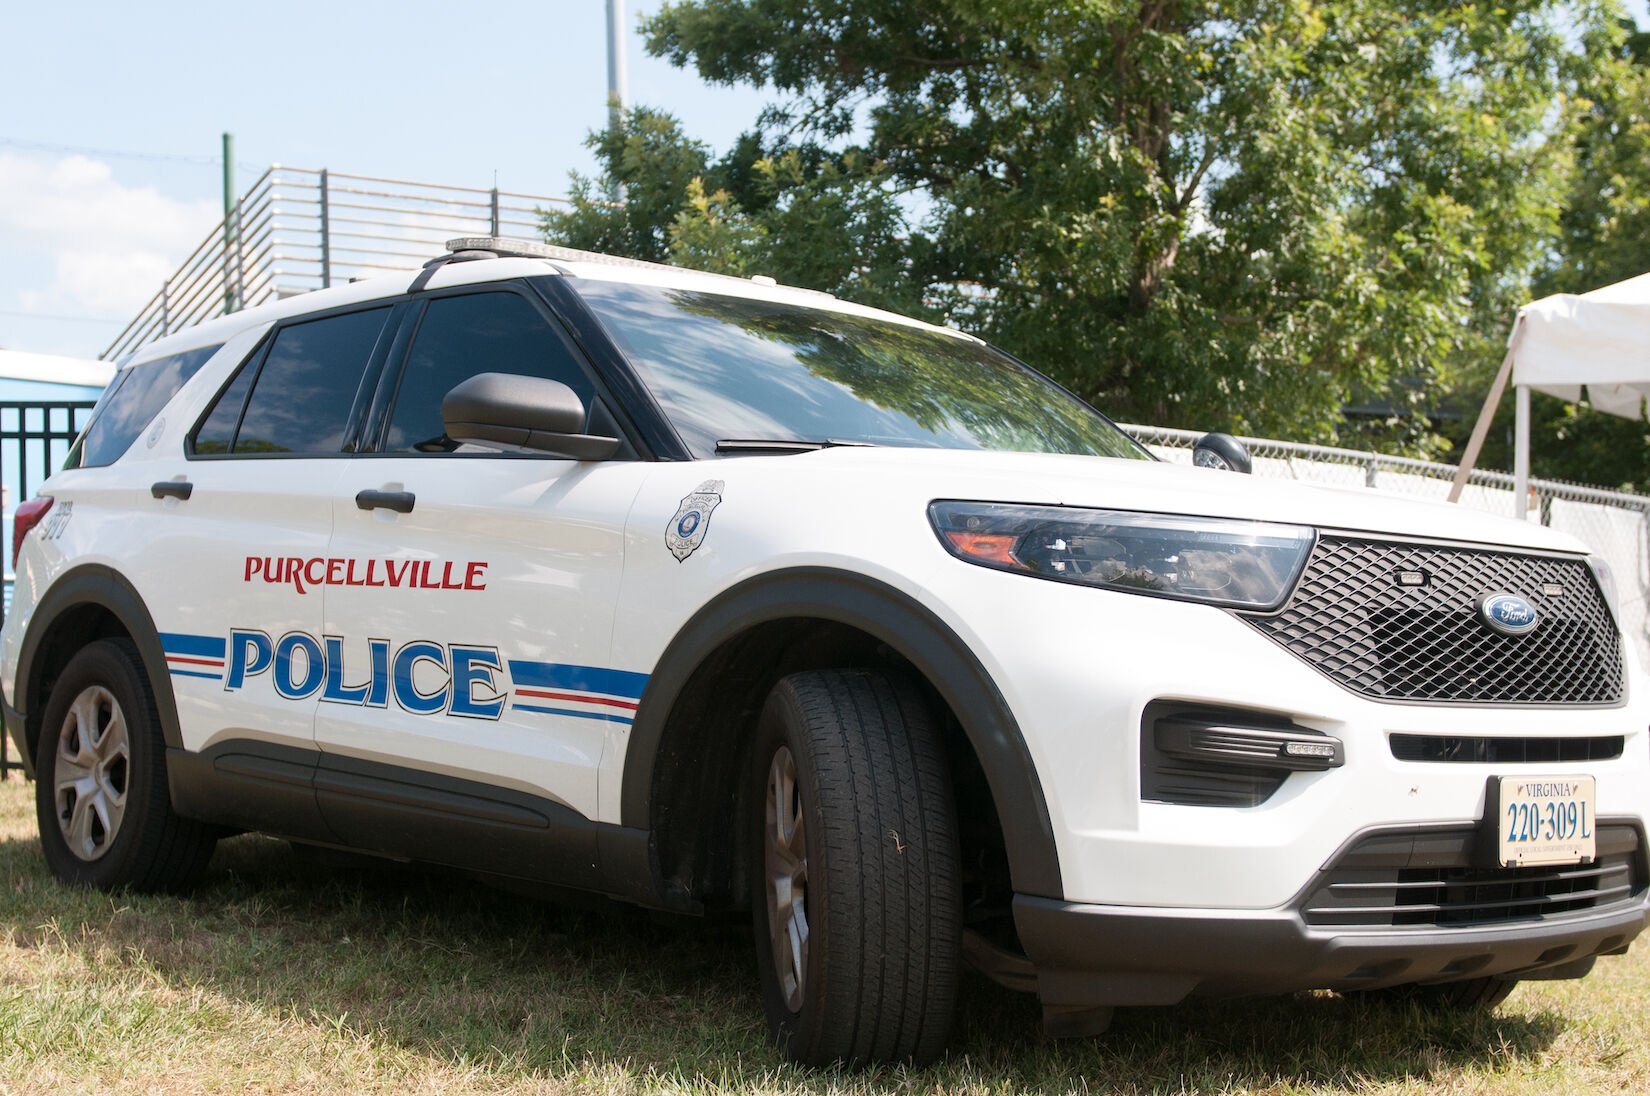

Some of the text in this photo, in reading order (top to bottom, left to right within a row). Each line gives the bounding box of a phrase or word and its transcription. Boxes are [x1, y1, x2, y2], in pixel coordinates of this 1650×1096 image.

[244, 556, 488, 595] PURCELLVILLE
[1500, 601, 1529, 622] Ford
[223, 627, 508, 721] POLICE
[1525, 783, 1571, 798] VIRGINIA
